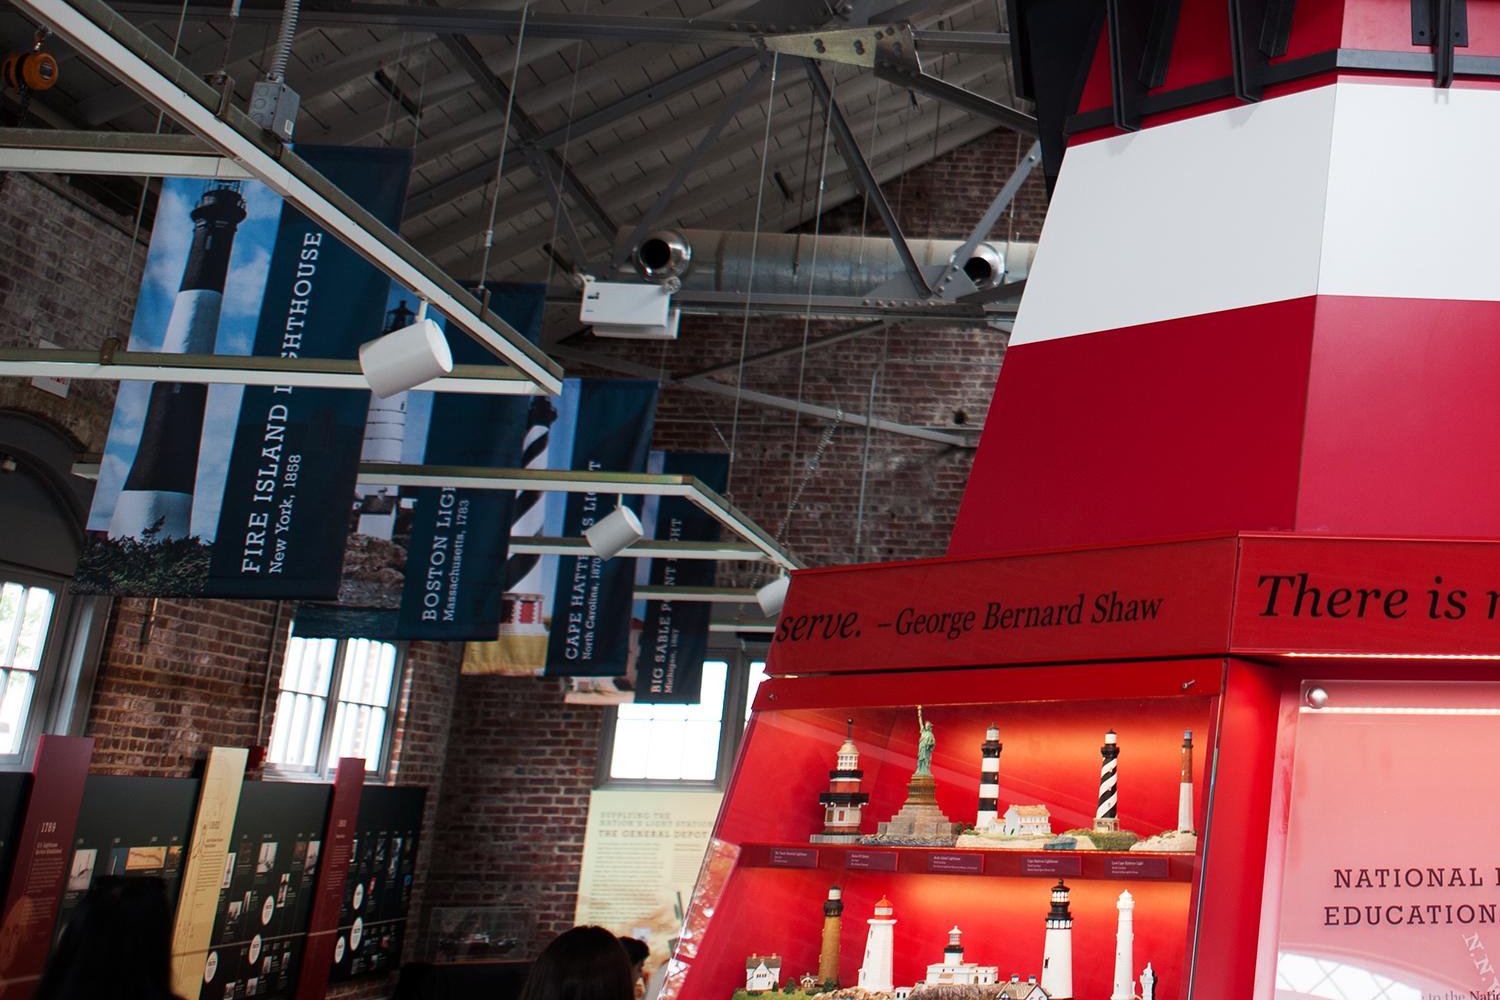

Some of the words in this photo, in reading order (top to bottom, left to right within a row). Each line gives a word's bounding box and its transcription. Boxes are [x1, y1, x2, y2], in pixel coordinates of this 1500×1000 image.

[273, 232, 323, 394] LHTHOUSE
[253, 404, 289, 502] ISLAND
[283, 454, 302, 488] 1858
[584, 461, 602, 512] LIT
[275, 494, 296, 535] York,
[241, 512, 269, 574] FIRE
[269, 539, 285, 574] New
[422, 535, 449, 621] BOSTON
[436, 486, 457, 527] LIG
[571, 516, 594, 607] HATTS
[661, 566, 677, 612] PNT
[1257, 573, 1410, 619] There
[1427, 576, 1468, 620] is
[565, 613, 582, 660] CAPE
[655, 617, 672, 663] SABLE
[775, 609, 863, 644] serve.
[982, 594, 1086, 631] Bernard
[1090, 590, 1164, 624] Shaw
[582, 631, 594, 660] North
[650, 668, 664, 694] BIG
[1333, 867, 1484, 889] NATIONAL
